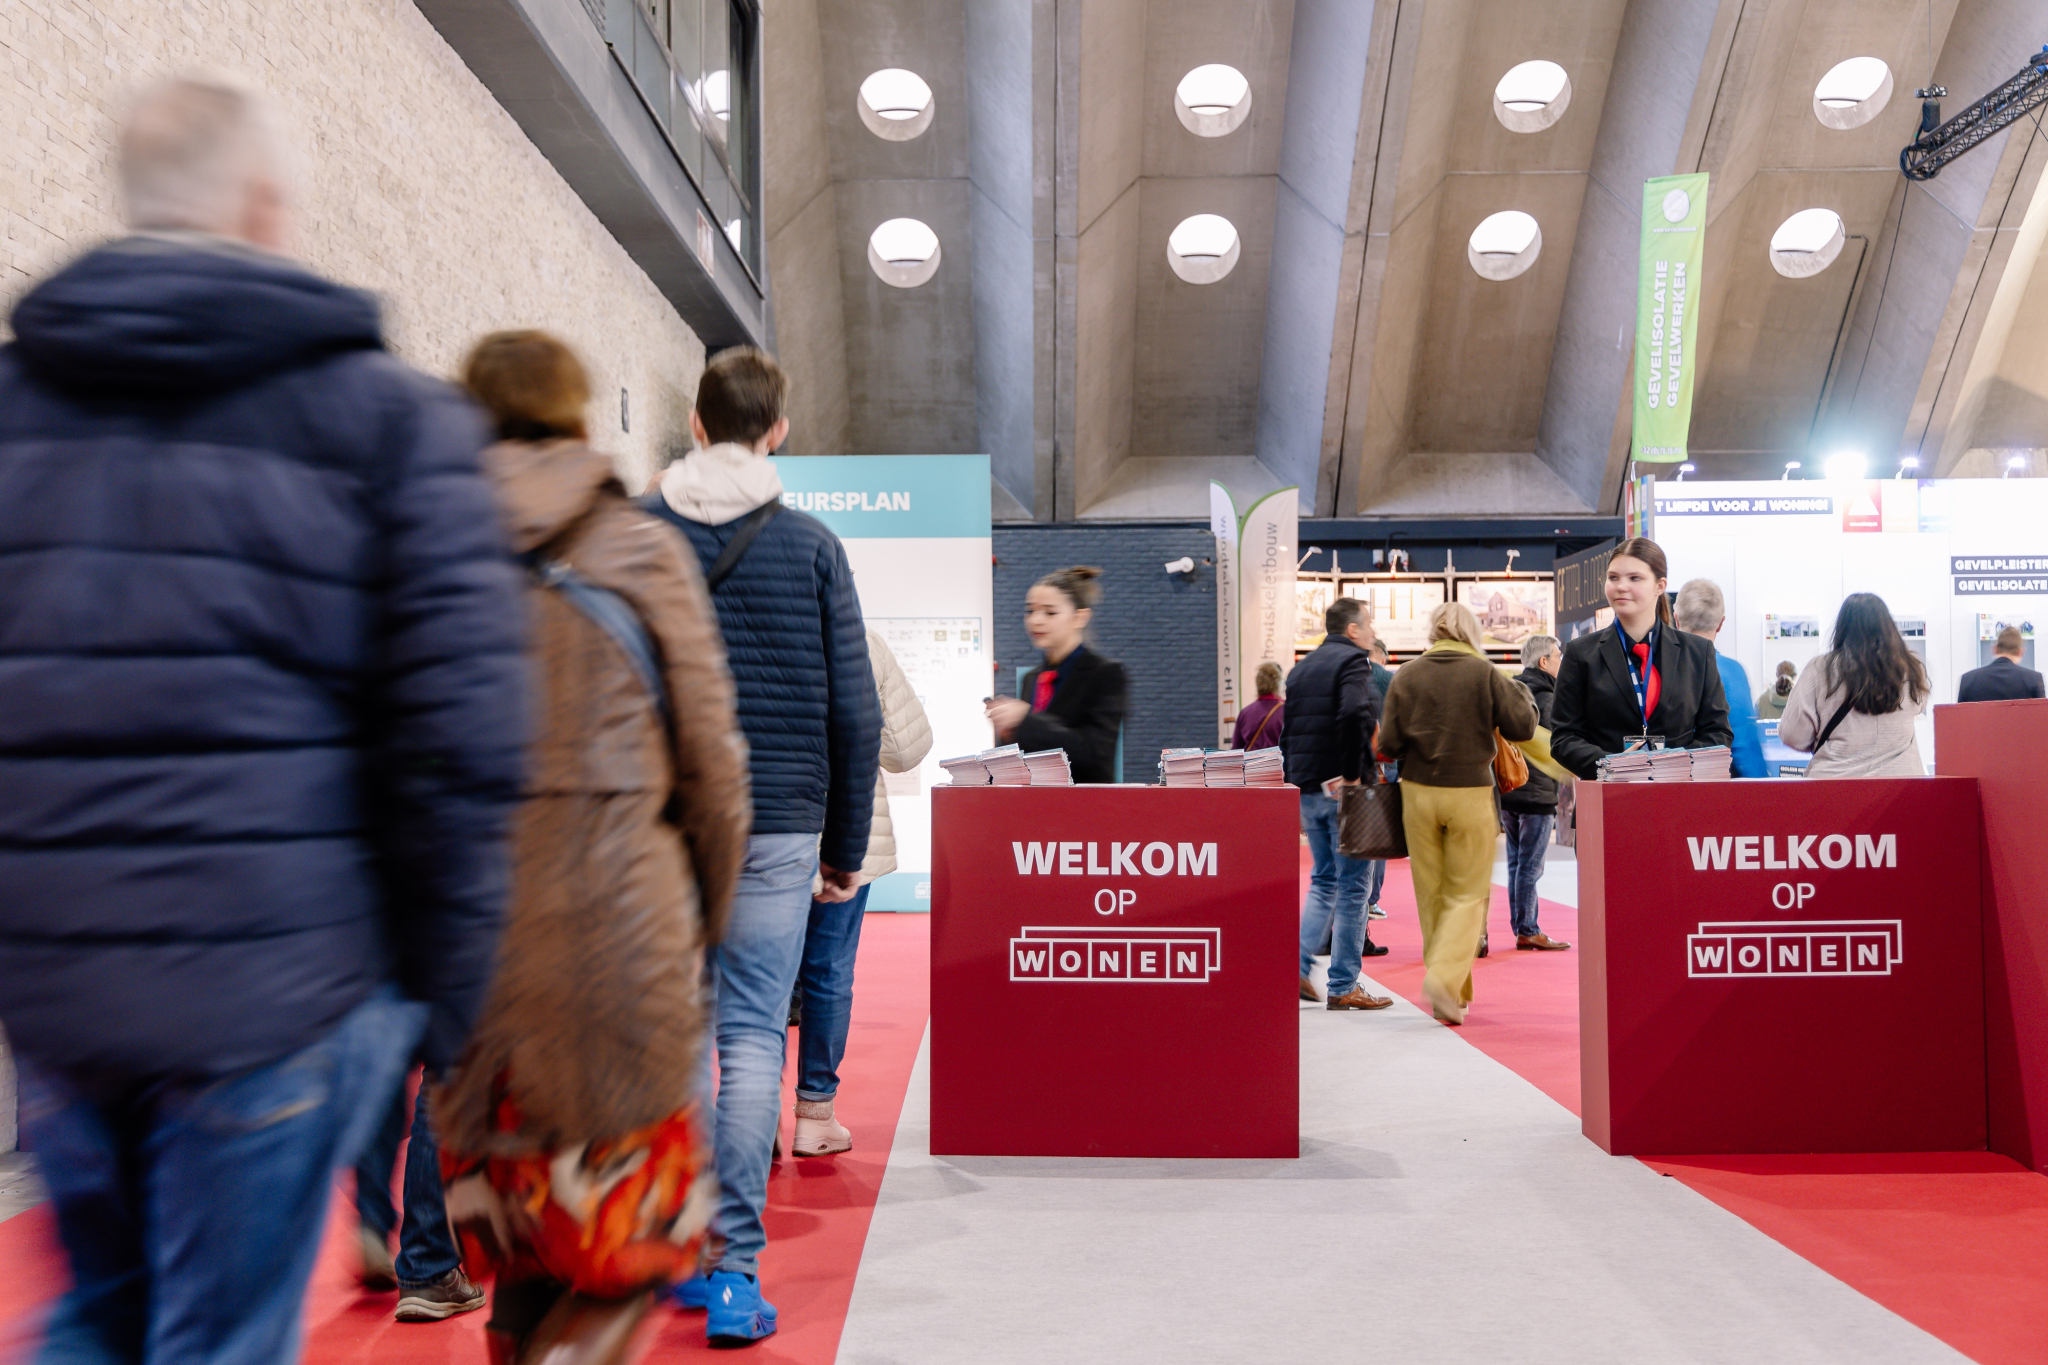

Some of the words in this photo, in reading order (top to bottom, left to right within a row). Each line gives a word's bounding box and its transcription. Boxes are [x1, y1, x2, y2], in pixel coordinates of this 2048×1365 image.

[1648, 259, 1669, 409] GEVELISOLATIE
[1666, 261, 1687, 408] GEVELWERKEN
[779, 491, 910, 511] EURSPLAN
[1665, 501, 1709, 512] LIEFDE
[1712, 500, 1750, 511] VOOR
[1752, 500, 1767, 511] JE
[1769, 499, 1828, 511] WONING!
[1260, 521, 1278, 660] houtskeletbouw
[1958, 579, 2048, 592] GEVELISOLATE
[1012, 841, 1218, 876] WELKOM
[1686, 833, 1898, 871] WELKOM
[1094, 888, 1137, 915] OP
[1771, 881, 1816, 909] OP
[1016, 950, 1197, 973] WONEN
[1695, 943, 1879, 968] WONEN
